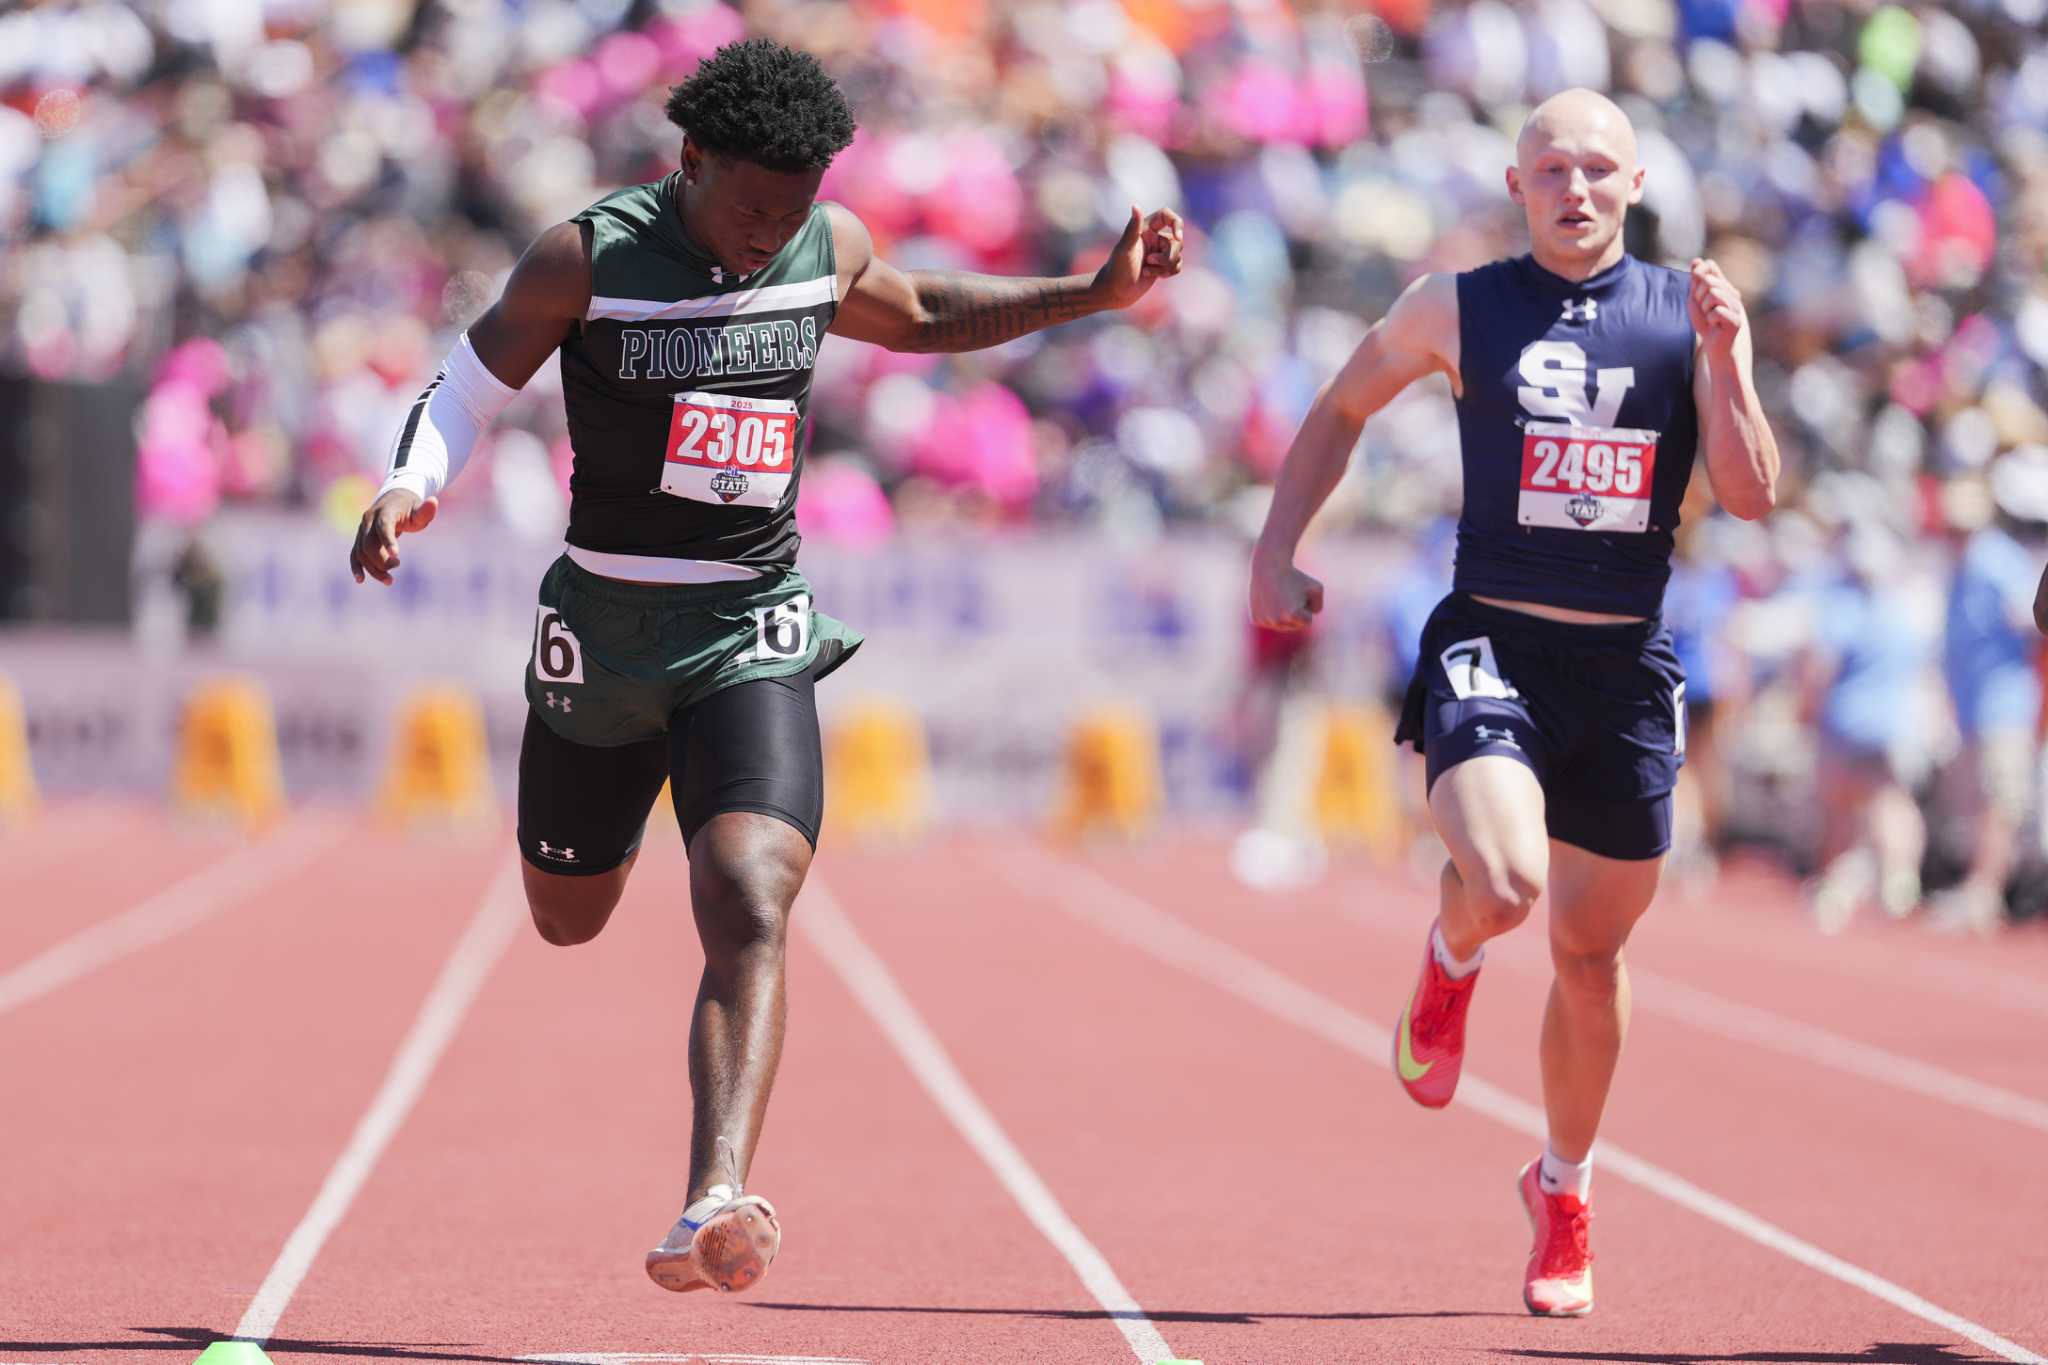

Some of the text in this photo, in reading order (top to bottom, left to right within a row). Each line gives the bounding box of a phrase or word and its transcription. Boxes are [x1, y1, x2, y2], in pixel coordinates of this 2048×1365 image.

[619, 316, 817, 379] PIONEERS
[1517, 340, 1635, 428] SV
[676, 410, 786, 466] 2305
[711, 479, 749, 491] STATE
[1531, 440, 1642, 493] 2495
[540, 613, 574, 678] 6
[763, 600, 801, 654] 6
[1447, 646, 1482, 693] 7
